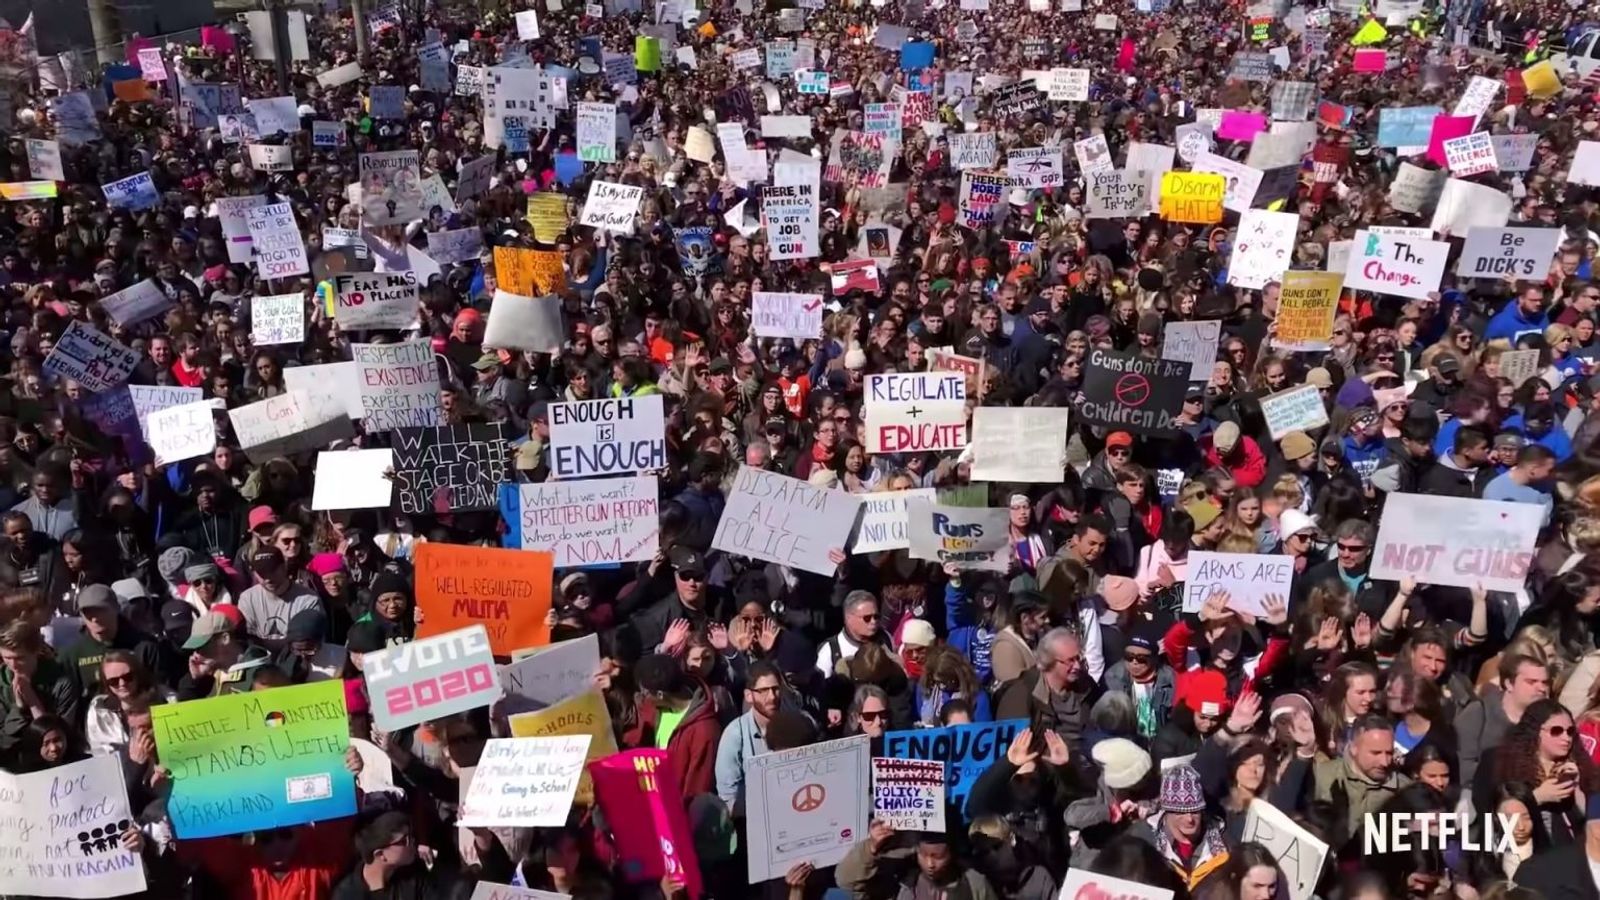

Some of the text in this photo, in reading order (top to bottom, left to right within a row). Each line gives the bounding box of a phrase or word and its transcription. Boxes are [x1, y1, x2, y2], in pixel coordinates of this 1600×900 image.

[952, 135, 994, 150] #NEVER
[958, 150, 993, 163] AGAIN
[1450, 148, 1492, 164] SILENCE
[971, 183, 1002, 195] MORE
[1092, 172, 1122, 183] YOUR
[799, 185, 812, 195] IN
[962, 209, 993, 221] THAN
[1102, 197, 1138, 210] TRUMP
[1175, 200, 1217, 221] HATE
[778, 224, 801, 235] JOB
[1500, 233, 1525, 246] Be
[260, 247, 300, 262] TO GO TO
[779, 243, 803, 254] GUN
[1394, 242, 1424, 265] The
[1504, 247, 1514, 257] a
[1475, 257, 1535, 274] DICK'S
[387, 271, 417, 287] HAS
[340, 288, 415, 307] NO PLACE IN
[1281, 298, 1299, 308] KILL
[1283, 288, 1304, 298] GUNS
[354, 341, 432, 364] RESPECT MY
[1091, 350, 1123, 372] Guns
[1125, 356, 1160, 375] don't
[364, 362, 438, 386] EXISTENCE
[170, 388, 197, 403] NOT
[361, 389, 439, 409] EXPECT MY
[872, 376, 965, 402] REGULATE
[159, 417, 180, 429] AM
[553, 399, 634, 425] ENOUGH
[1081, 400, 1155, 426] Children
[161, 424, 213, 451] NEXT?
[395, 422, 484, 450] WILL
[879, 423, 965, 452] EDUCATE
[393, 439, 511, 469] WALK THE
[556, 438, 664, 475] ENOUGH
[397, 463, 463, 492] STAGE
[490, 459, 512, 484] BE
[522, 485, 561, 508] What
[581, 491, 595, 501] we
[599, 483, 635, 500] want?
[739, 470, 828, 513] DISARM
[523, 498, 658, 528] STRICTER GUN REFORM
[747, 501, 792, 534] ALL
[523, 530, 556, 544] When
[559, 526, 572, 541] do
[575, 528, 593, 538] we
[595, 523, 619, 536] want
[718, 516, 813, 565] POLICE
[567, 537, 623, 563] NOW!
[1382, 543, 1533, 579] NOT GUNS
[1195, 559, 1291, 584] ARMS ARE
[452, 598, 509, 620] MILITIA
[364, 632, 487, 682] I VOTE
[386, 663, 494, 716] 2020
[152, 711, 236, 745] TURTLE
[166, 730, 342, 781] STANDS WITH
[888, 725, 1016, 763] ENOUGH
[777, 759, 838, 786] PEACE
[540, 778, 571, 793] School
[875, 786, 921, 798] POLICY
[171, 792, 274, 828] PARKLAND
[874, 797, 935, 810] CHANGE
[50, 796, 115, 837] protect
